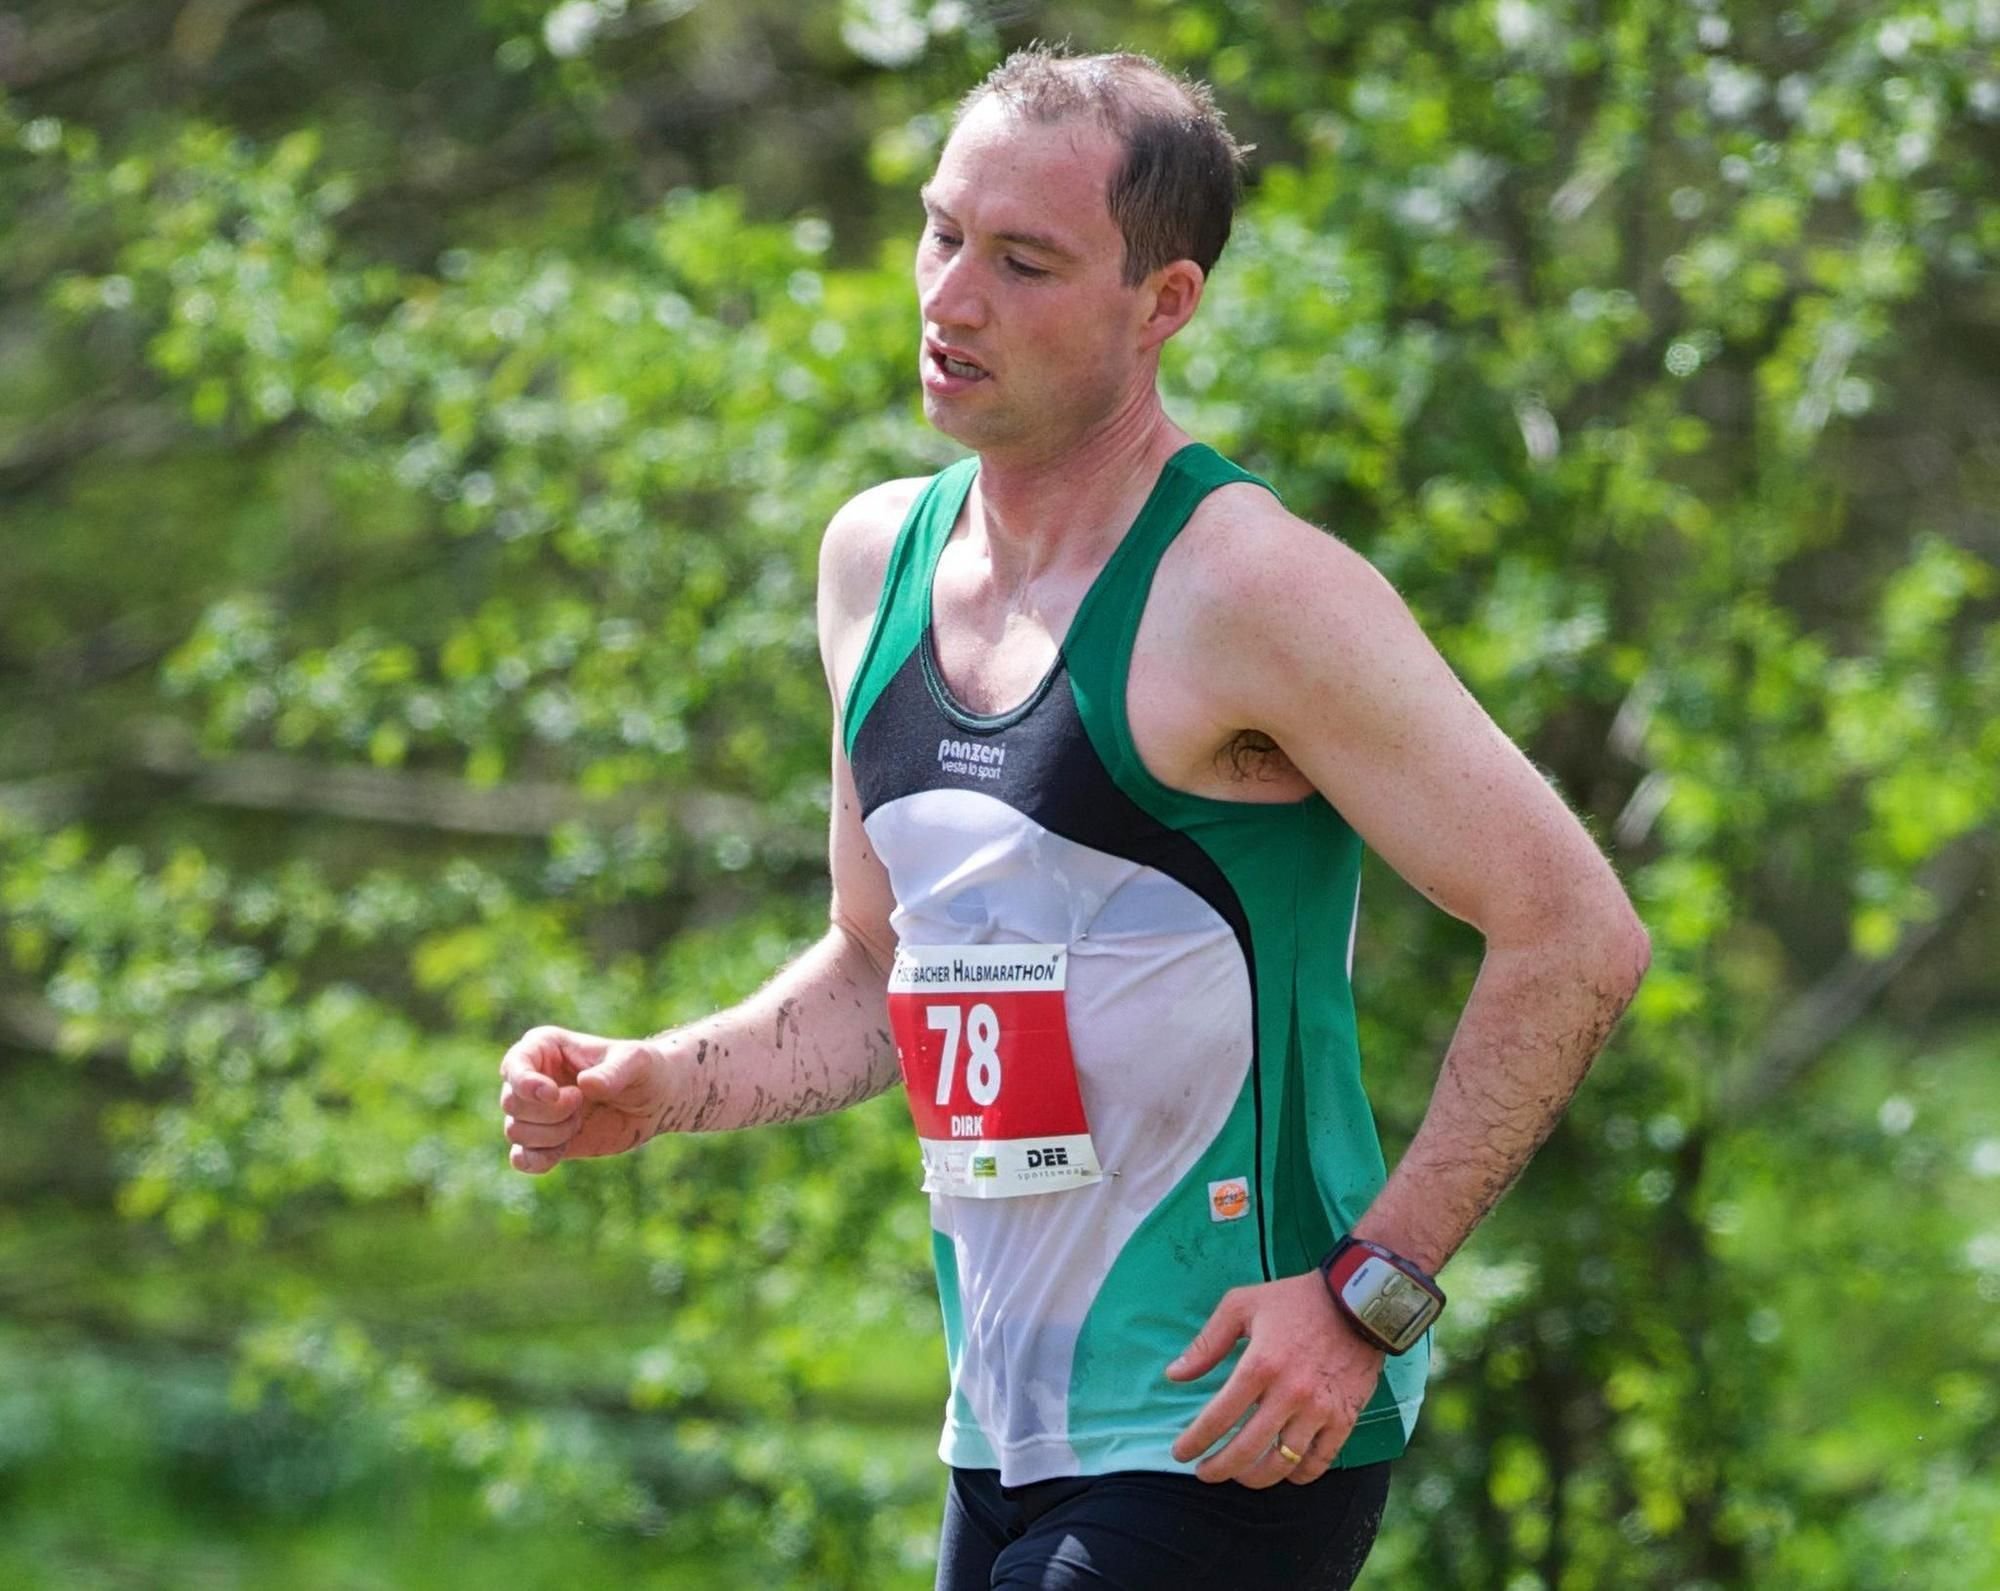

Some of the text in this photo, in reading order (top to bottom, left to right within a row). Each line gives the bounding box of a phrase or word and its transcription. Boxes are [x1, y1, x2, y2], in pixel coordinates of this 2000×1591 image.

[937, 739, 1006, 765] panzeri
[968, 763, 977, 775] lo
[978, 765, 1001, 780] sport
[953, 959, 1056, 982] HALBMARATHON
[926, 1003, 1002, 1106] 78
[951, 1115, 984, 1137] DIRK
[1027, 1147, 1069, 1168] DEE
